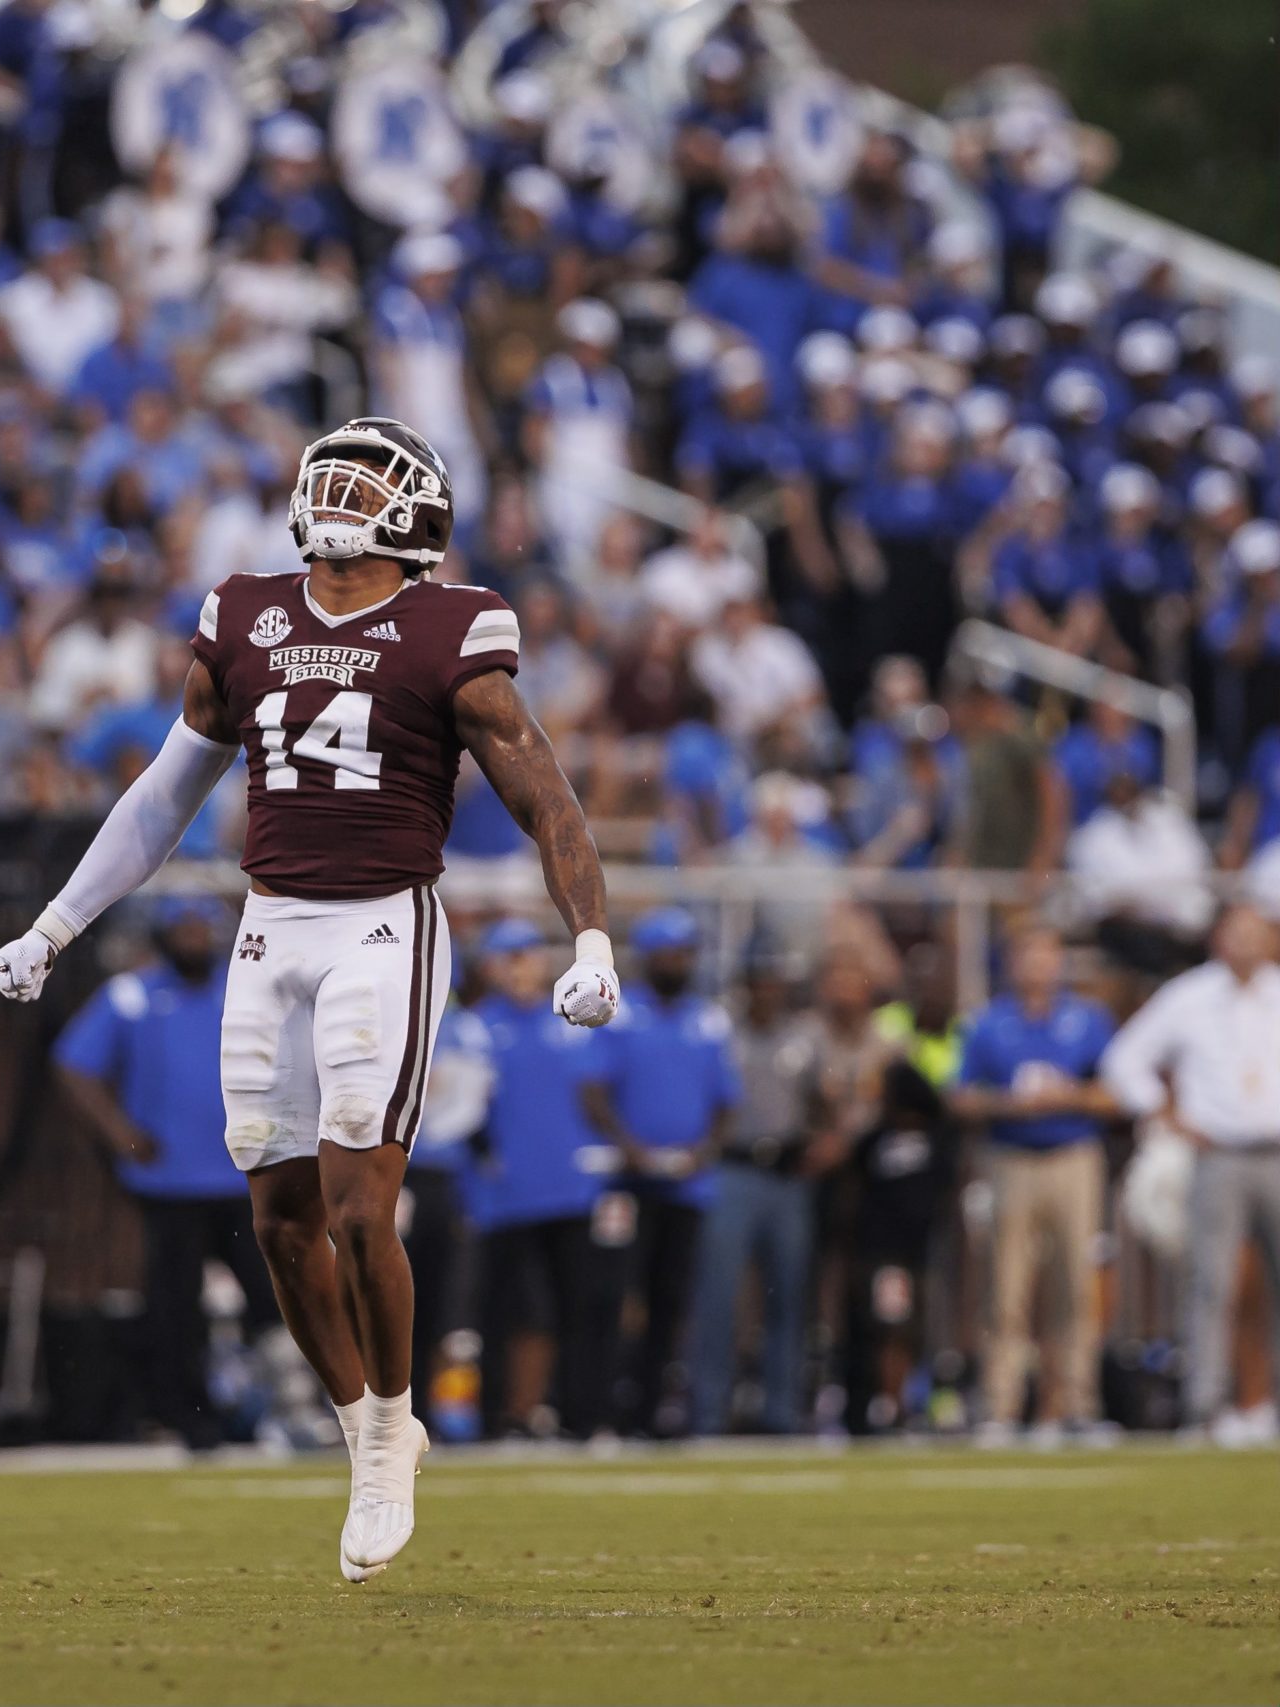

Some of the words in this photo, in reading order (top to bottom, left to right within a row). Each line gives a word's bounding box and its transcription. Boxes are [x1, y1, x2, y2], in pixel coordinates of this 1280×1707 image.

[258, 609, 285, 637] SEC
[363, 628, 401, 642] adidas
[269, 649, 380, 669] MISSISSIPPI
[296, 665, 343, 681] STATE
[255, 691, 382, 790] 14
[361, 936, 400, 945] adidas
